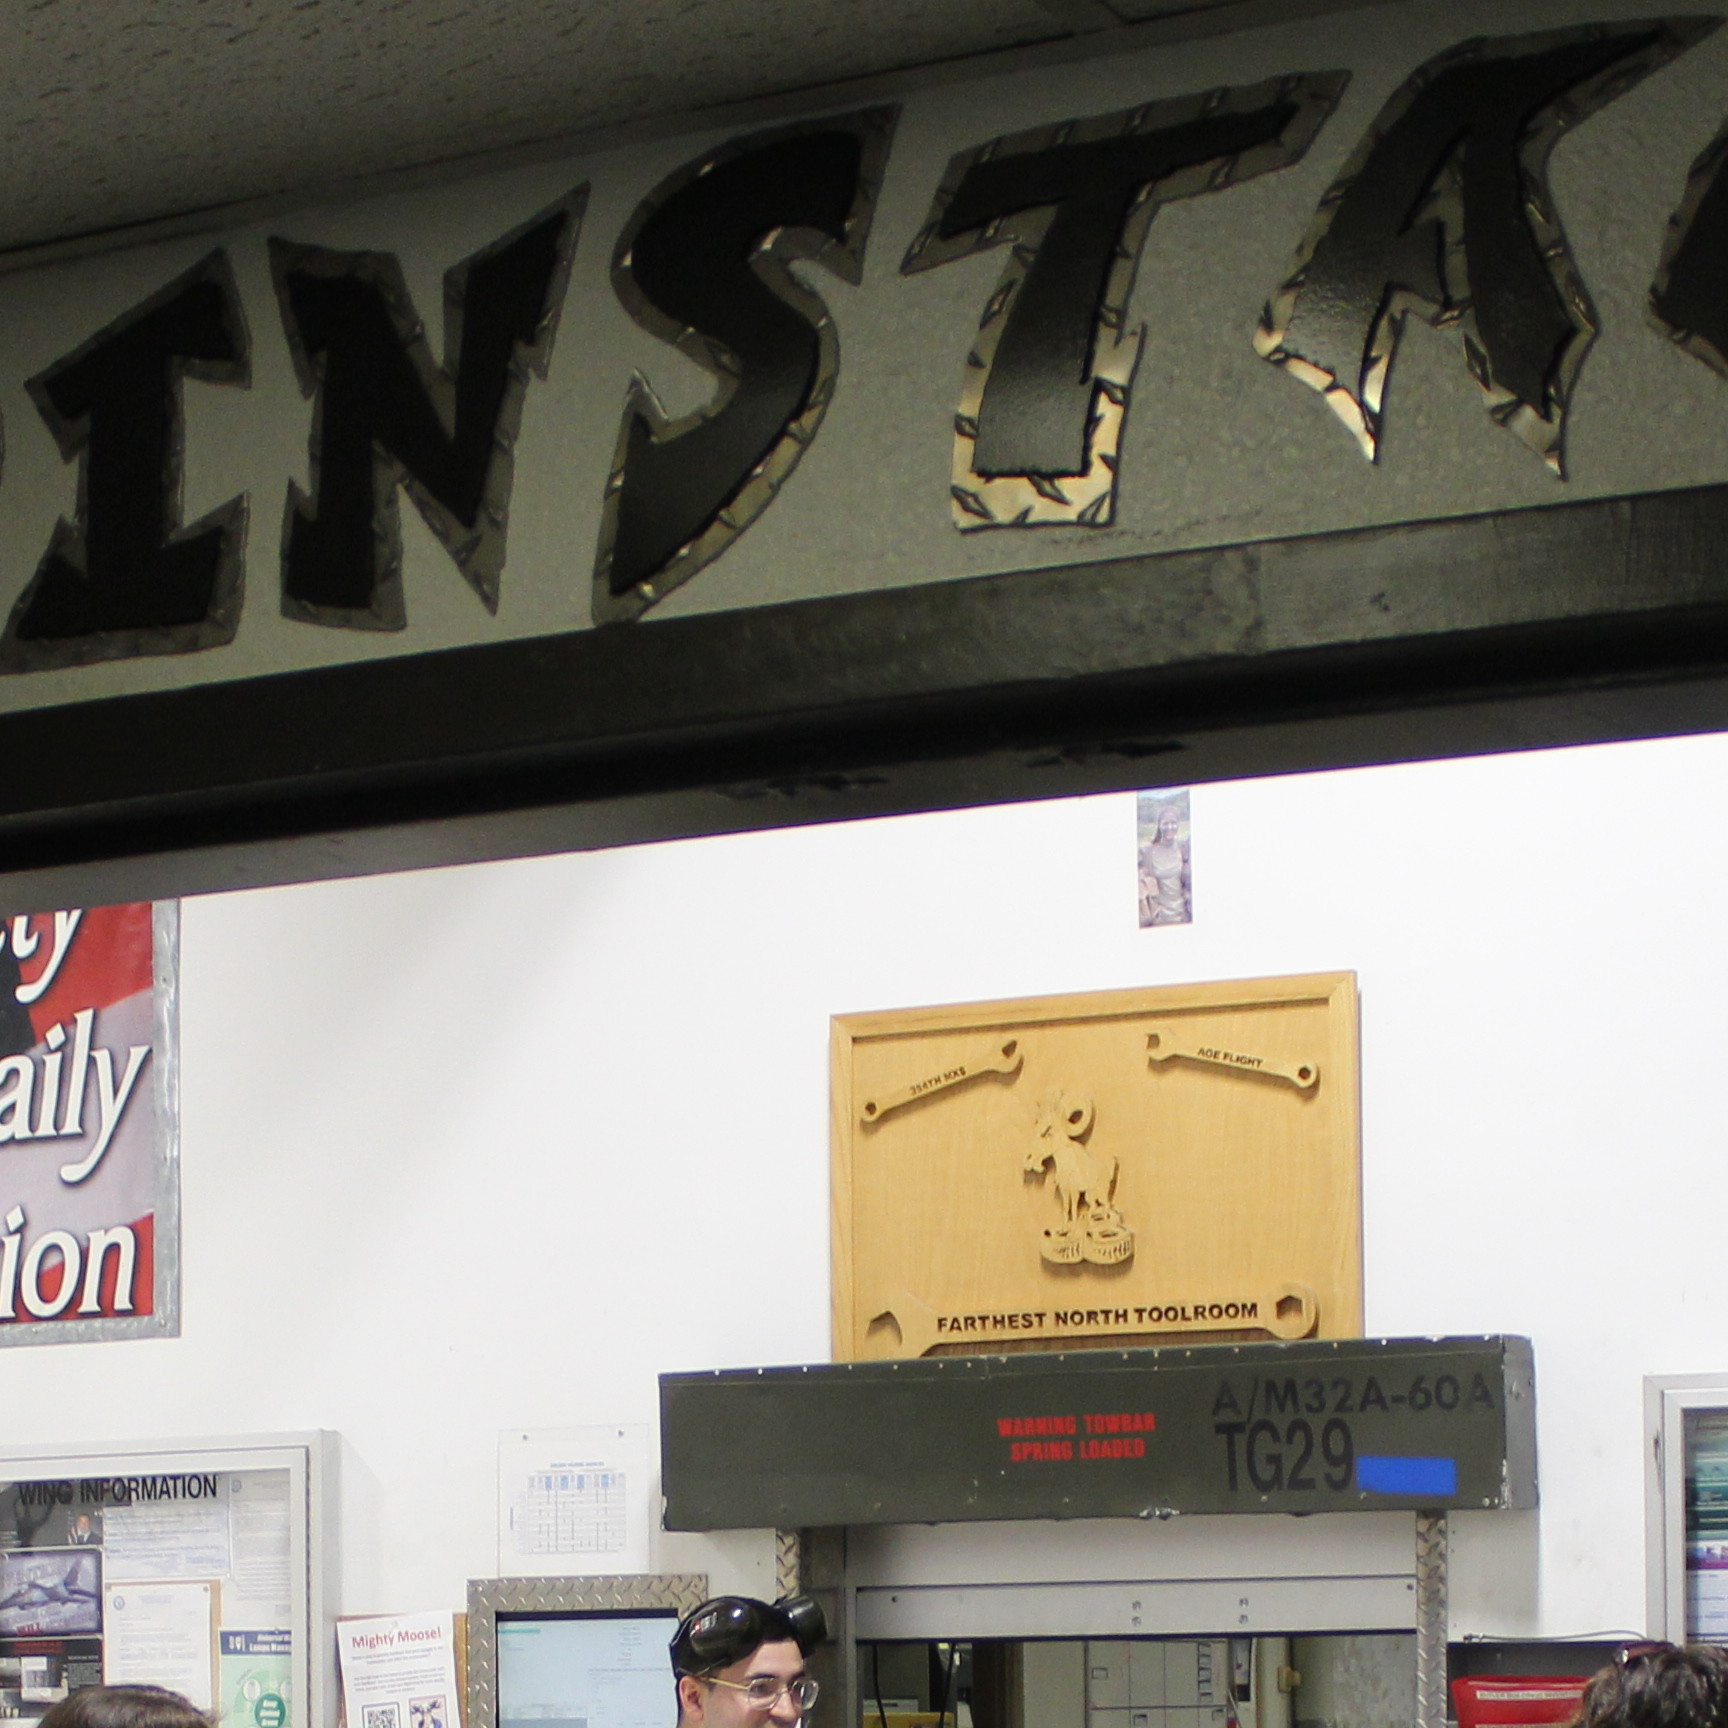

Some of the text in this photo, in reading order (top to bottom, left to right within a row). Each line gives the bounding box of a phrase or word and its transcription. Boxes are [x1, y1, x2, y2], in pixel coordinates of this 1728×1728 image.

[1223, 1052, 1263, 1068] FLIGHT
[936, 1302, 1258, 1332] FARTHEST NORTH TOOLROOM
[1212, 1374, 1496, 1423] A/M32A-60A
[997, 1413, 1156, 1437] WARNING TOWBAR
[1010, 1438, 1145, 1462] SPRING LOADED
[1214, 1418, 1355, 1493] TG29
[19, 1474, 218, 1505] WING INFORMATION
[352, 1633, 394, 1648] Mighty
